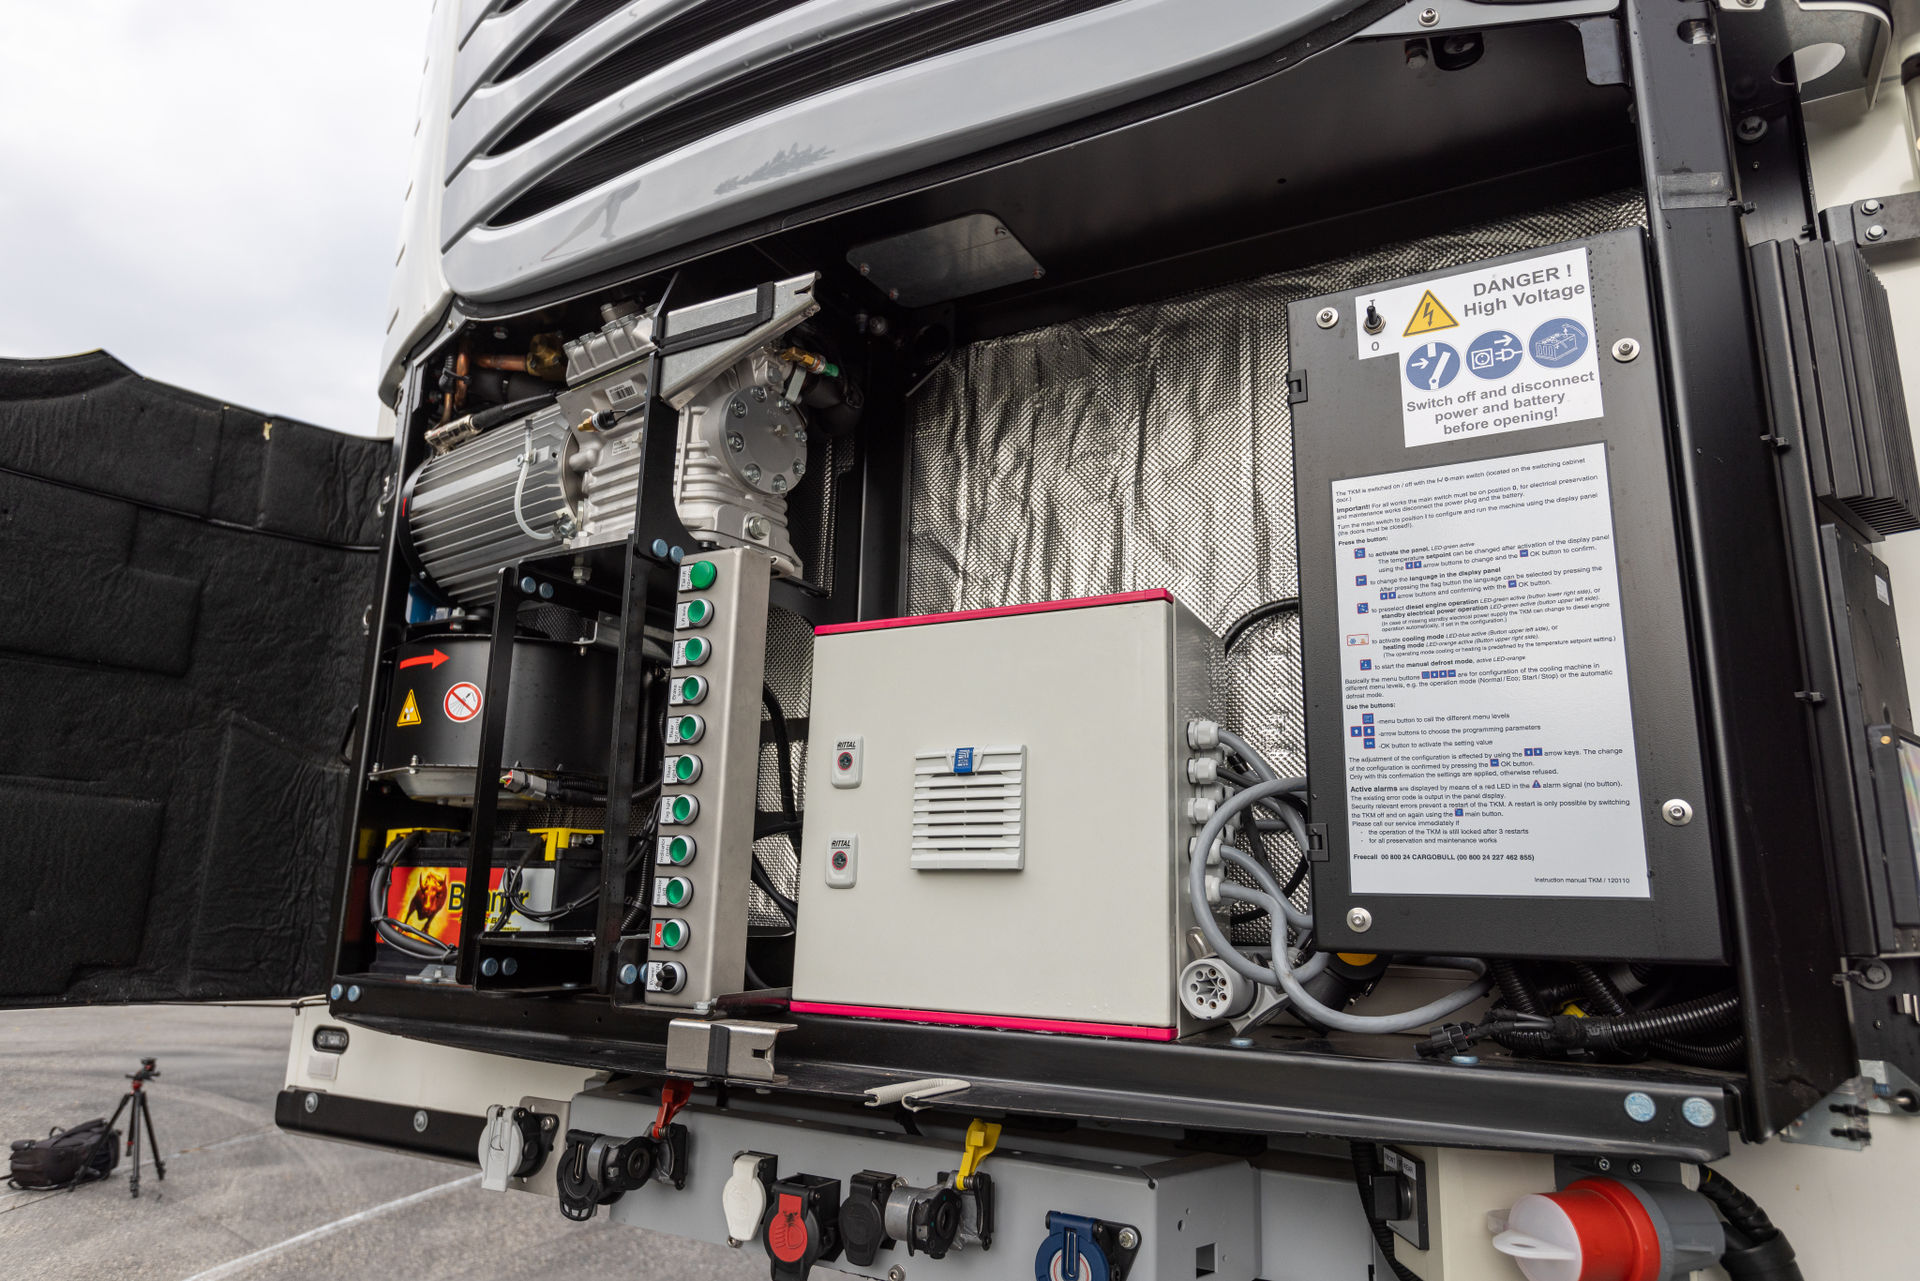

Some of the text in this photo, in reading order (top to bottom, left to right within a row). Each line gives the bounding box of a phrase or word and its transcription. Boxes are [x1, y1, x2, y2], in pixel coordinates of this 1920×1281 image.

[1473, 264, 1572, 297] DANGER !
[1463, 281, 1586, 318] High Voltage
[1406, 371, 1595, 413] Switch off and disconnect
[1434, 391, 1566, 425] power and battery
[1443, 407, 1558, 436] before opening!
